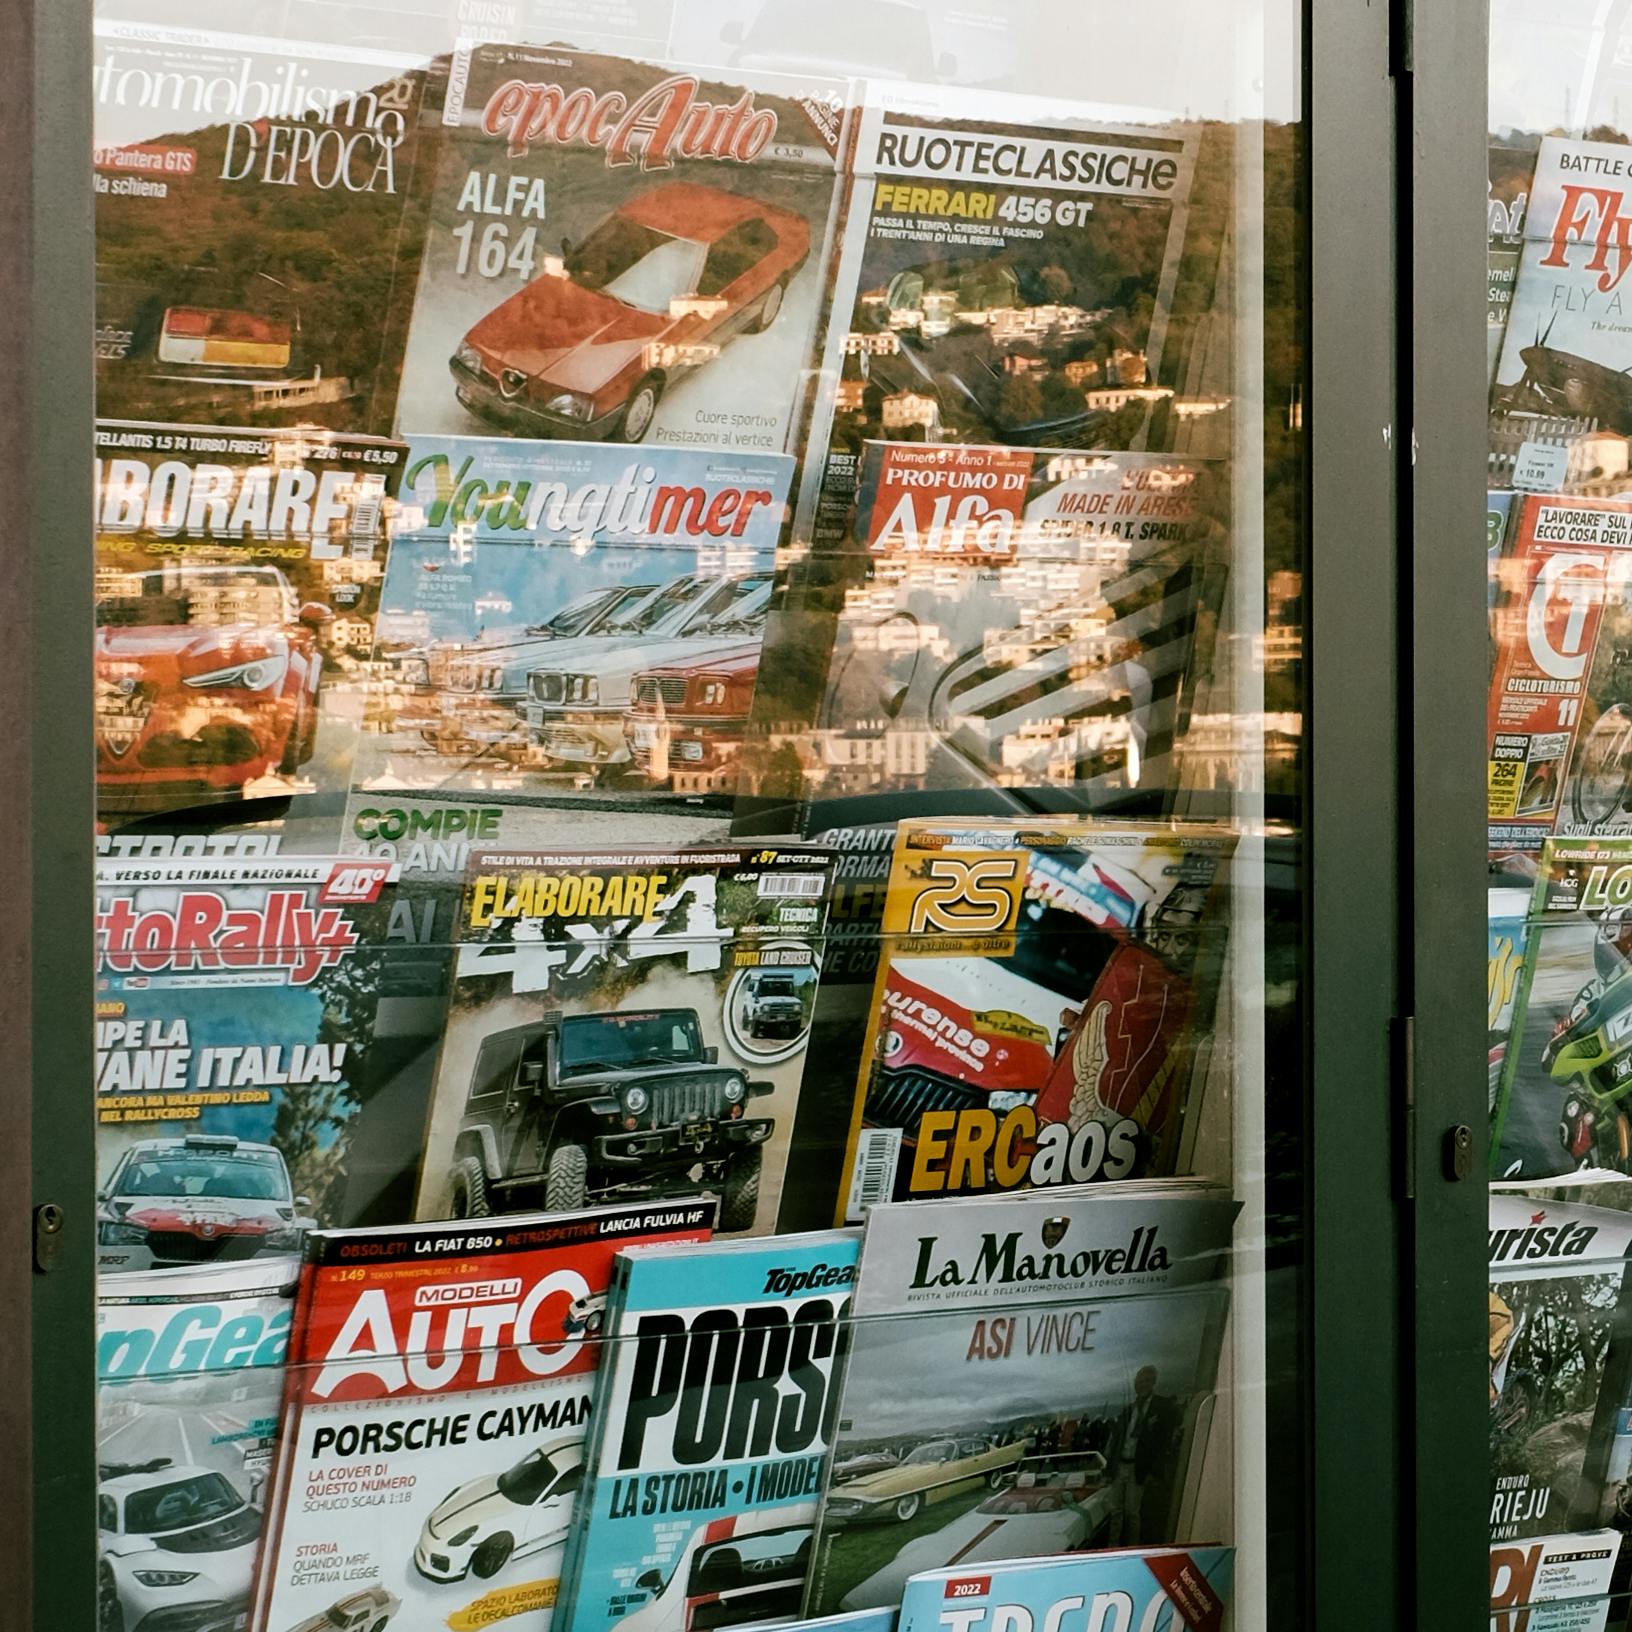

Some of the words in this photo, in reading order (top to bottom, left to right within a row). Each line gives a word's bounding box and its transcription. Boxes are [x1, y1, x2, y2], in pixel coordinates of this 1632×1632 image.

[482, 72, 779, 172] epocAuto
[105, 146, 163, 169] Pantera
[217, 121, 398, 195] D'EPOCA
[1558, 152, 1624, 178] BATTLE
[110, 176, 169, 200] schiena
[456, 170, 547, 220] ALFA
[873, 183, 998, 220] FERRARI
[998, 196, 1052, 225] 456
[1055, 200, 1095, 228] GT
[452, 220, 538, 280] 164
[1550, 284, 1599, 314] FLY
[404, 452, 774, 542] Youngtimer
[885, 466, 999, 490] PROFUMO
[1002, 473, 1026, 490] DI
[869, 491, 1017, 553] Alfa
[1056, 492, 1112, 515] MADE
[1535, 523, 1568, 541] ECCO
[1567, 526, 1599, 544] COSA
[1599, 528, 1626, 546] DEVI
[1505, 677, 1582, 695] CICLOTURISMO
[352, 807, 502, 841] COMPIE
[115, 869, 161, 881] VERSO
[470, 872, 667, 928] ELABORARE
[778, 906, 818, 924] TECNICA
[456, 874, 735, 995] 4x4
[197, 1042, 347, 1088] ITALIA!
[909, 1103, 1141, 1193] ERCaos
[434, 1236, 463, 1253] FIAT
[465, 1234, 494, 1251] 850
[599, 1216, 641, 1235] LANCIA
[641, 1212, 686, 1232] FULVIA
[908, 1236, 967, 1290] La
[966, 1225, 1175, 1286] Manovella
[417, 1278, 521, 1306] MODELLI
[309, 1267, 595, 1399] AUTO
[965, 1315, 1018, 1363] ASI
[1024, 1309, 1102, 1357] VINCE
[309, 1408, 472, 1460] PORSCHE
[305, 1479, 359, 1499] QUESTO
[360, 1474, 418, 1492] NUMERO
[329, 1464, 370, 1480] COVER
[639, 1469, 730, 1517] STORIA
[1490, 1486, 1551, 1526] RIEJU
[296, 1541, 339, 1558] STORIA
[953, 1582, 982, 1597] 2022
